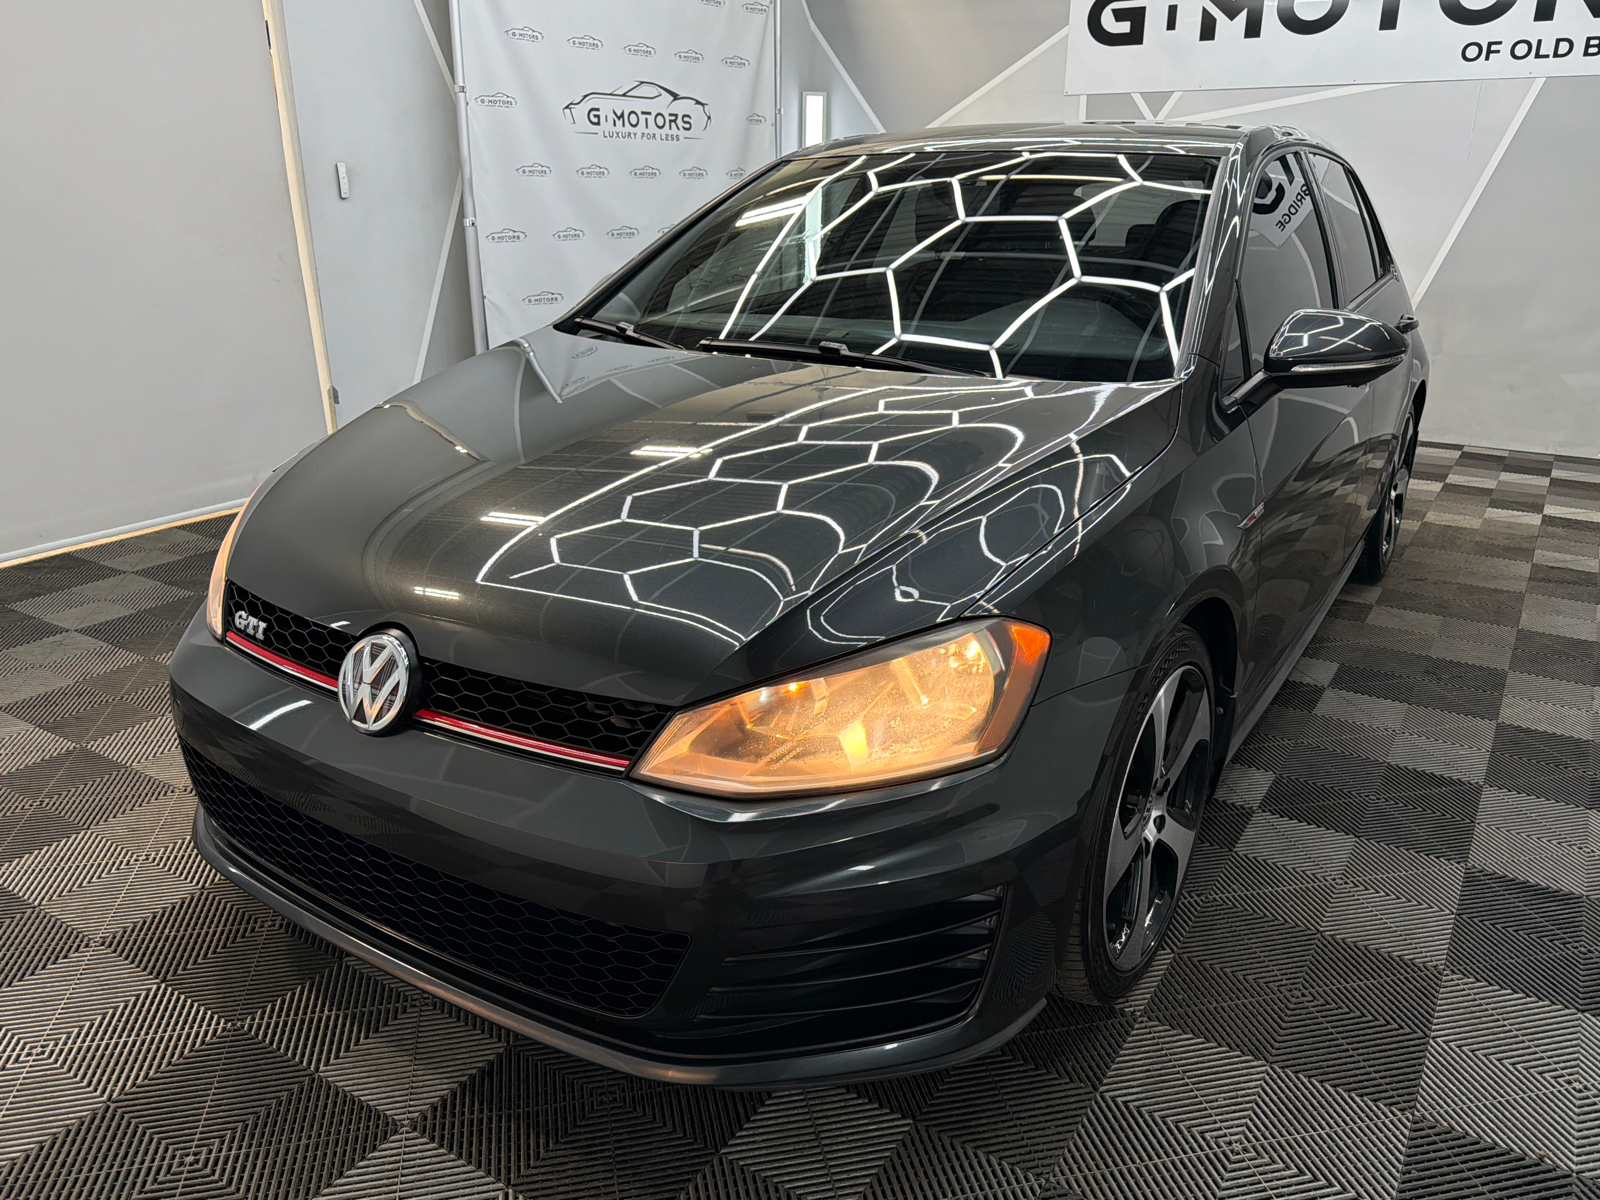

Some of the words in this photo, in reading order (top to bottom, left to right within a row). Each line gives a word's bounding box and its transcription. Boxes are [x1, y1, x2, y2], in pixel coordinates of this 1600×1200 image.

[1461, 40, 1503, 62] OF
[1510, 37, 1575, 60] OLD
[602, 130, 637, 140] LUXURY
[640, 132, 656, 141] FOR
[660, 133, 680, 142] LESS
[235, 610, 267, 641] GTI
